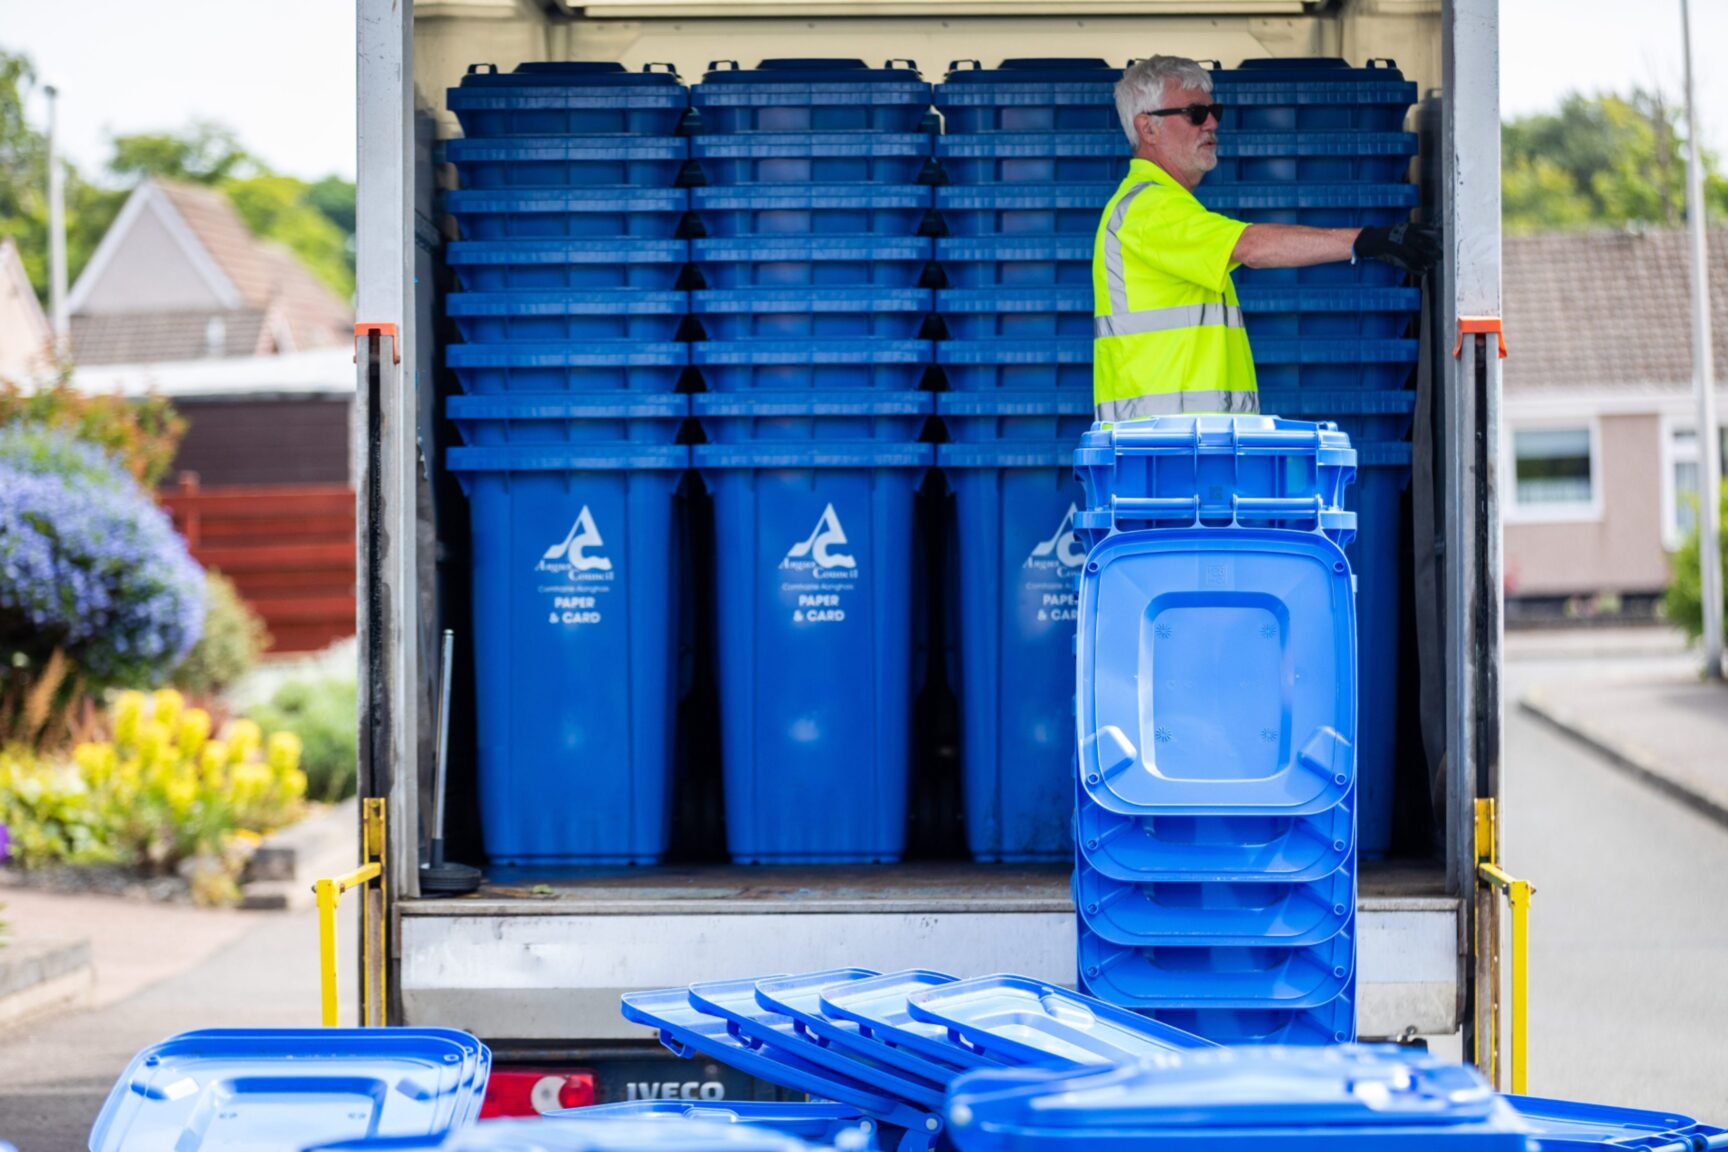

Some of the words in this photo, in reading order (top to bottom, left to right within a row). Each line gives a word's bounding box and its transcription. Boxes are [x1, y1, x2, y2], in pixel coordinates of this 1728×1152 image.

[812, 567, 858, 579] Council
[554, 596, 595, 608] PAPER
[798, 594, 840, 606] PAPER
[548, 611, 560, 624] &
[562, 611, 602, 624] CARD
[793, 609, 804, 622] &
[806, 609, 846, 622] CARD
[1037, 609, 1047, 621] &
[1050, 608, 1078, 621] CAR
[626, 1081, 725, 1101] IVECO
